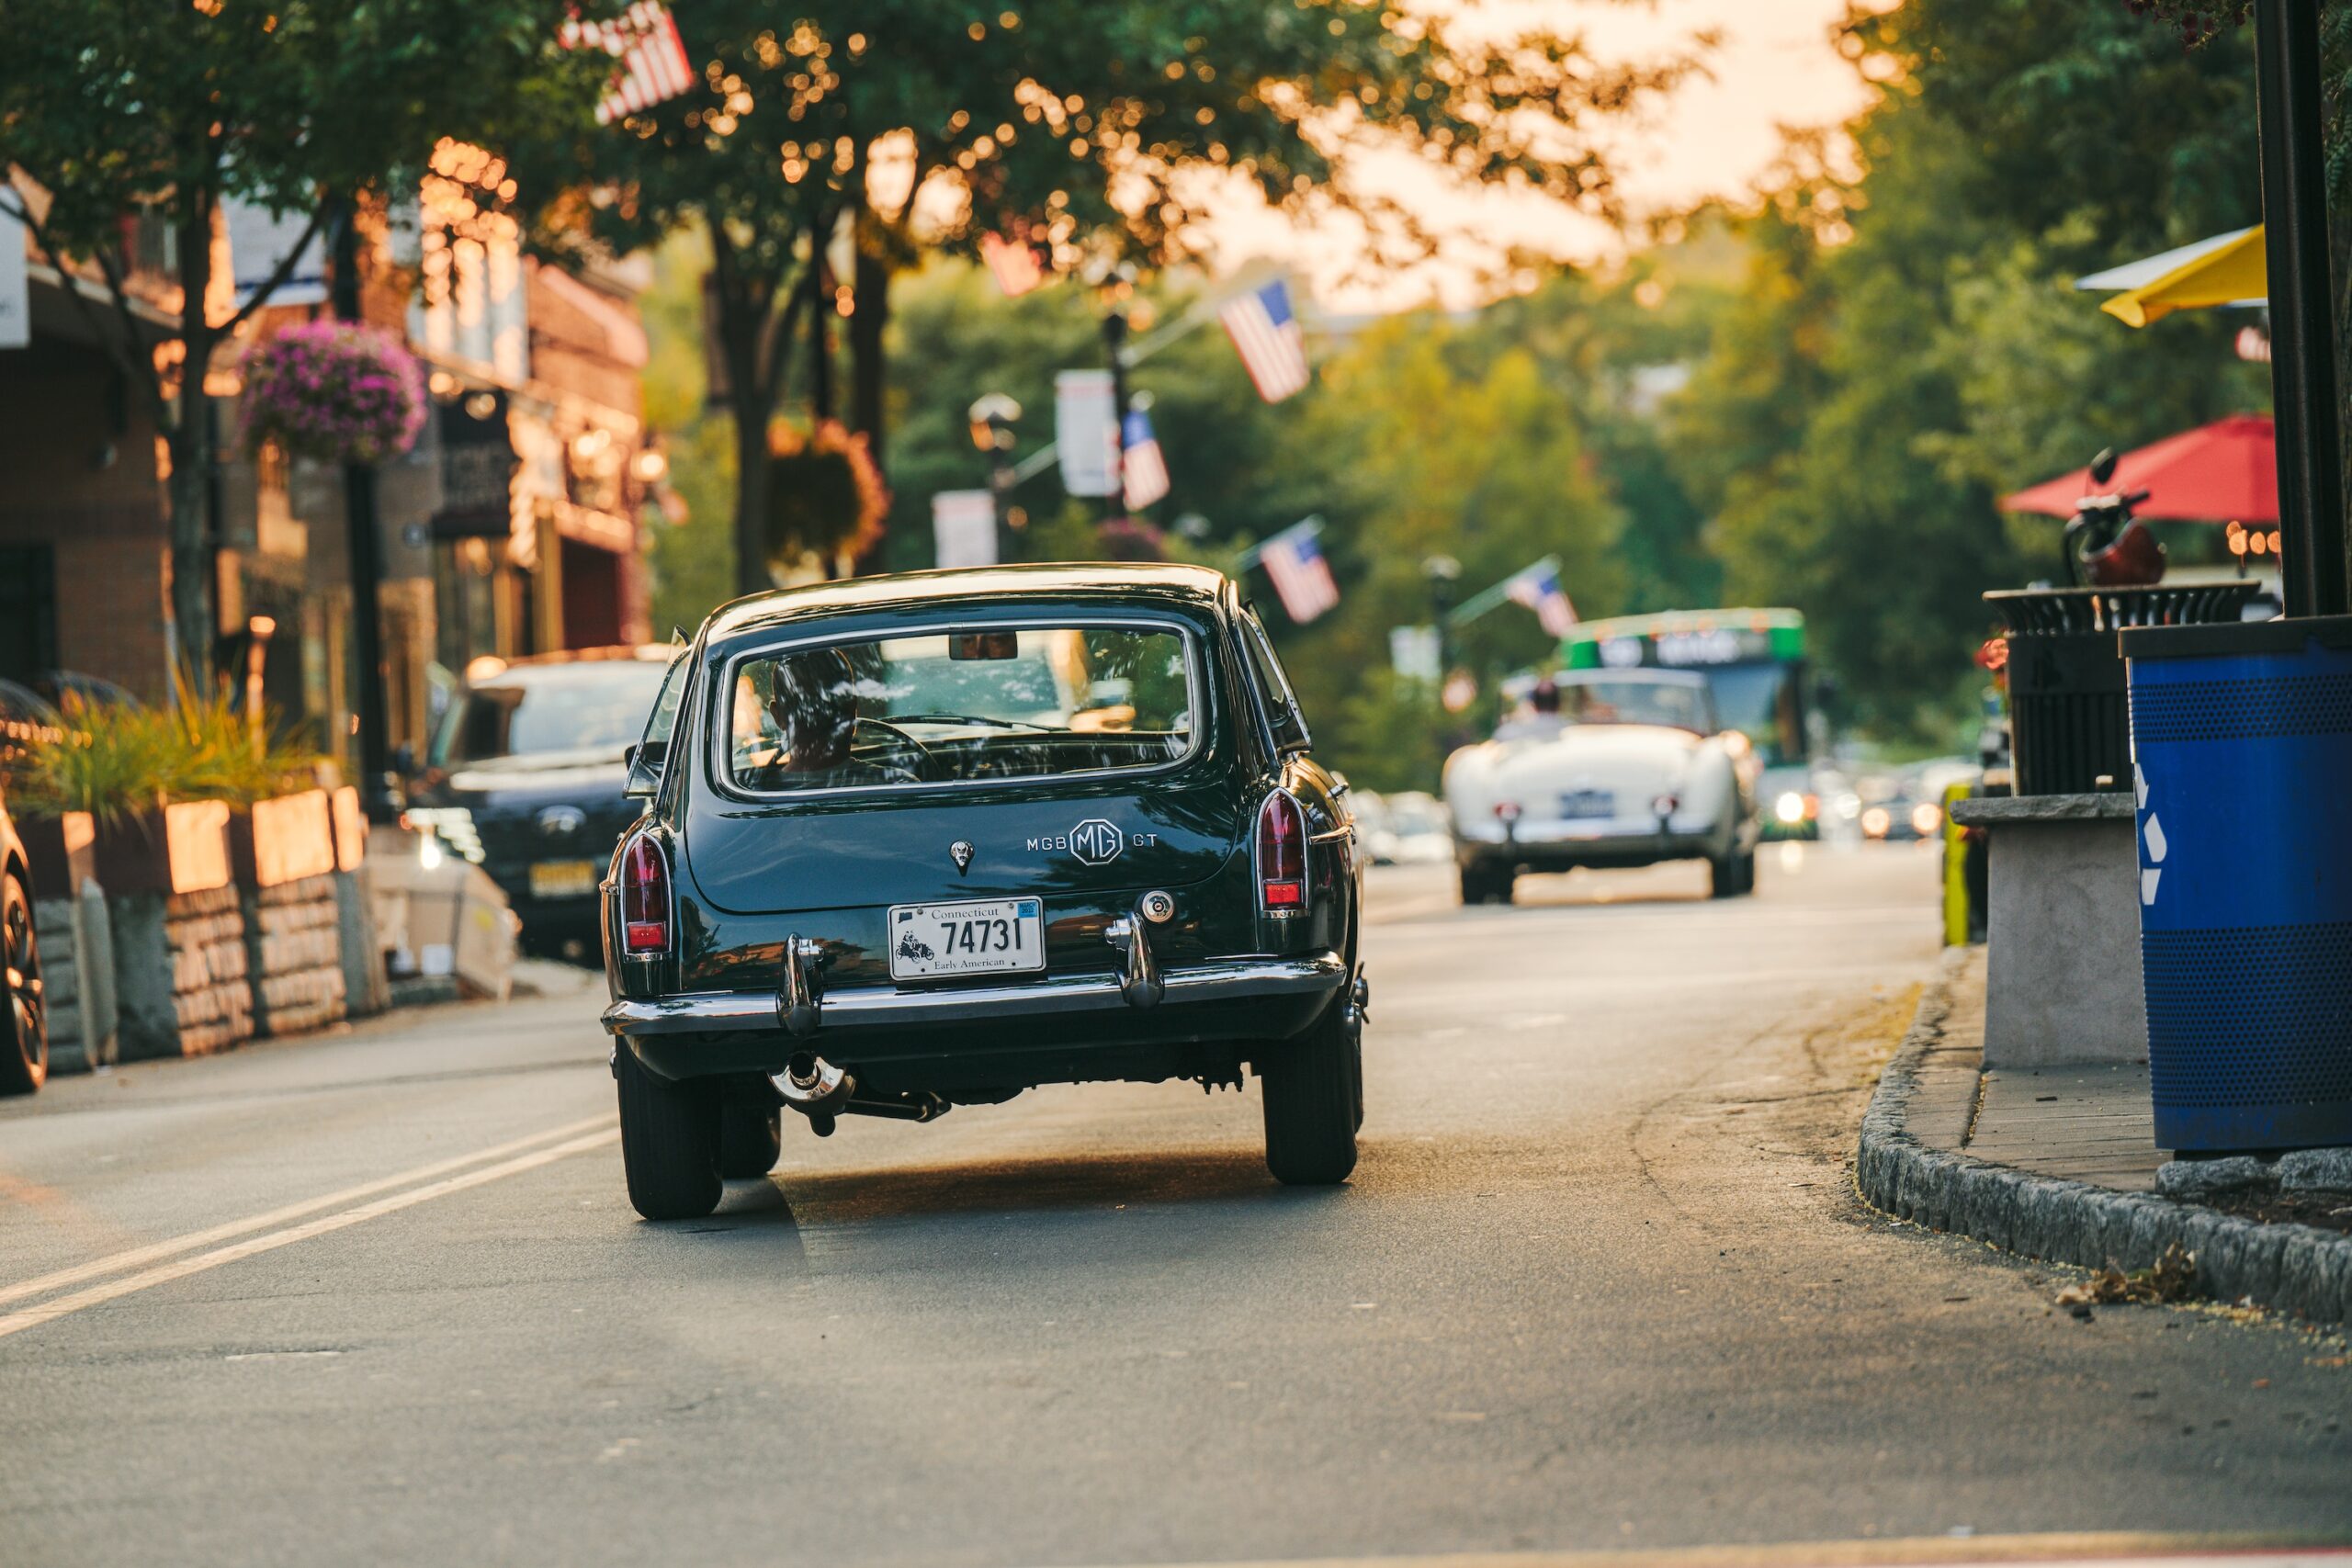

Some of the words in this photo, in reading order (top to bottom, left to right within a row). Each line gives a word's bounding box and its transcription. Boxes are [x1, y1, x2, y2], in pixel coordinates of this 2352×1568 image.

[1027, 837, 1067, 852] MGB
[1077, 824, 1116, 859] MG
[1133, 833, 1158, 847] GT
[932, 908, 999, 919] Connecticut
[941, 919, 1022, 954] 74731
[934, 959, 958, 970] Early
[960, 958, 1005, 968] American
